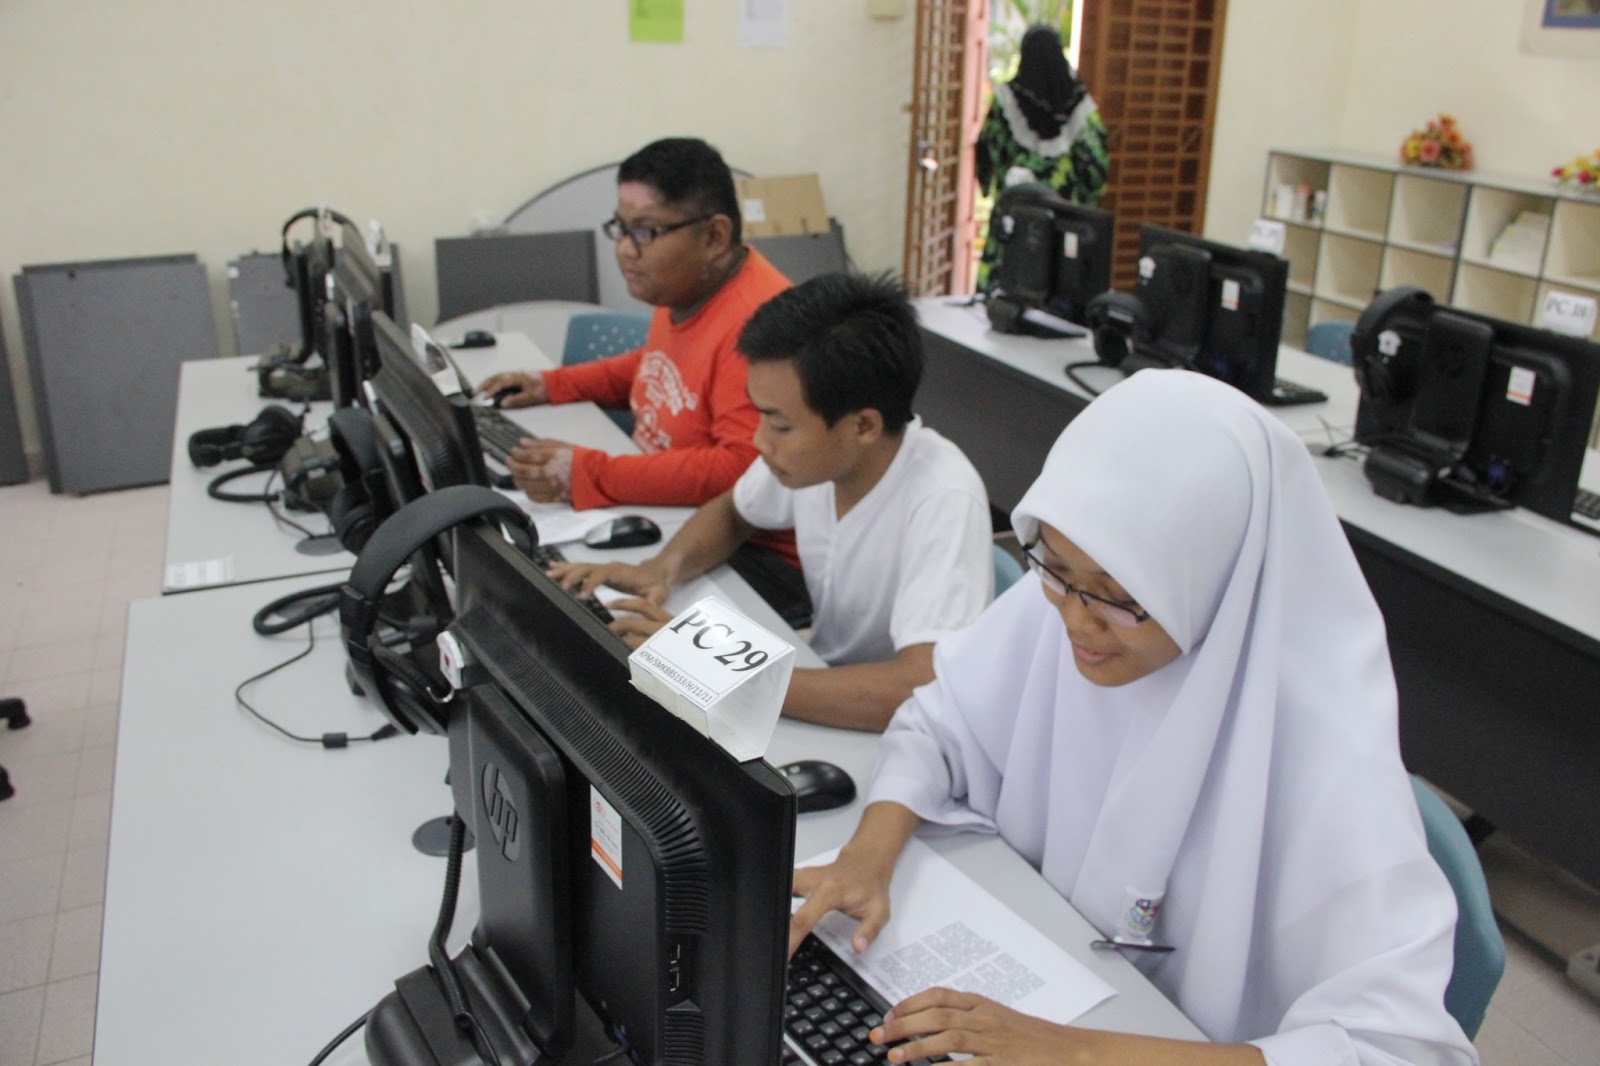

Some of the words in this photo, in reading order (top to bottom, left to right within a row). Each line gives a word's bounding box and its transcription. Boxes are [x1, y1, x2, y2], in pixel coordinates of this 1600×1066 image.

[670, 609, 735, 650] PC
[714, 640, 769, 672] 29
[487, 767, 519, 862] hp
